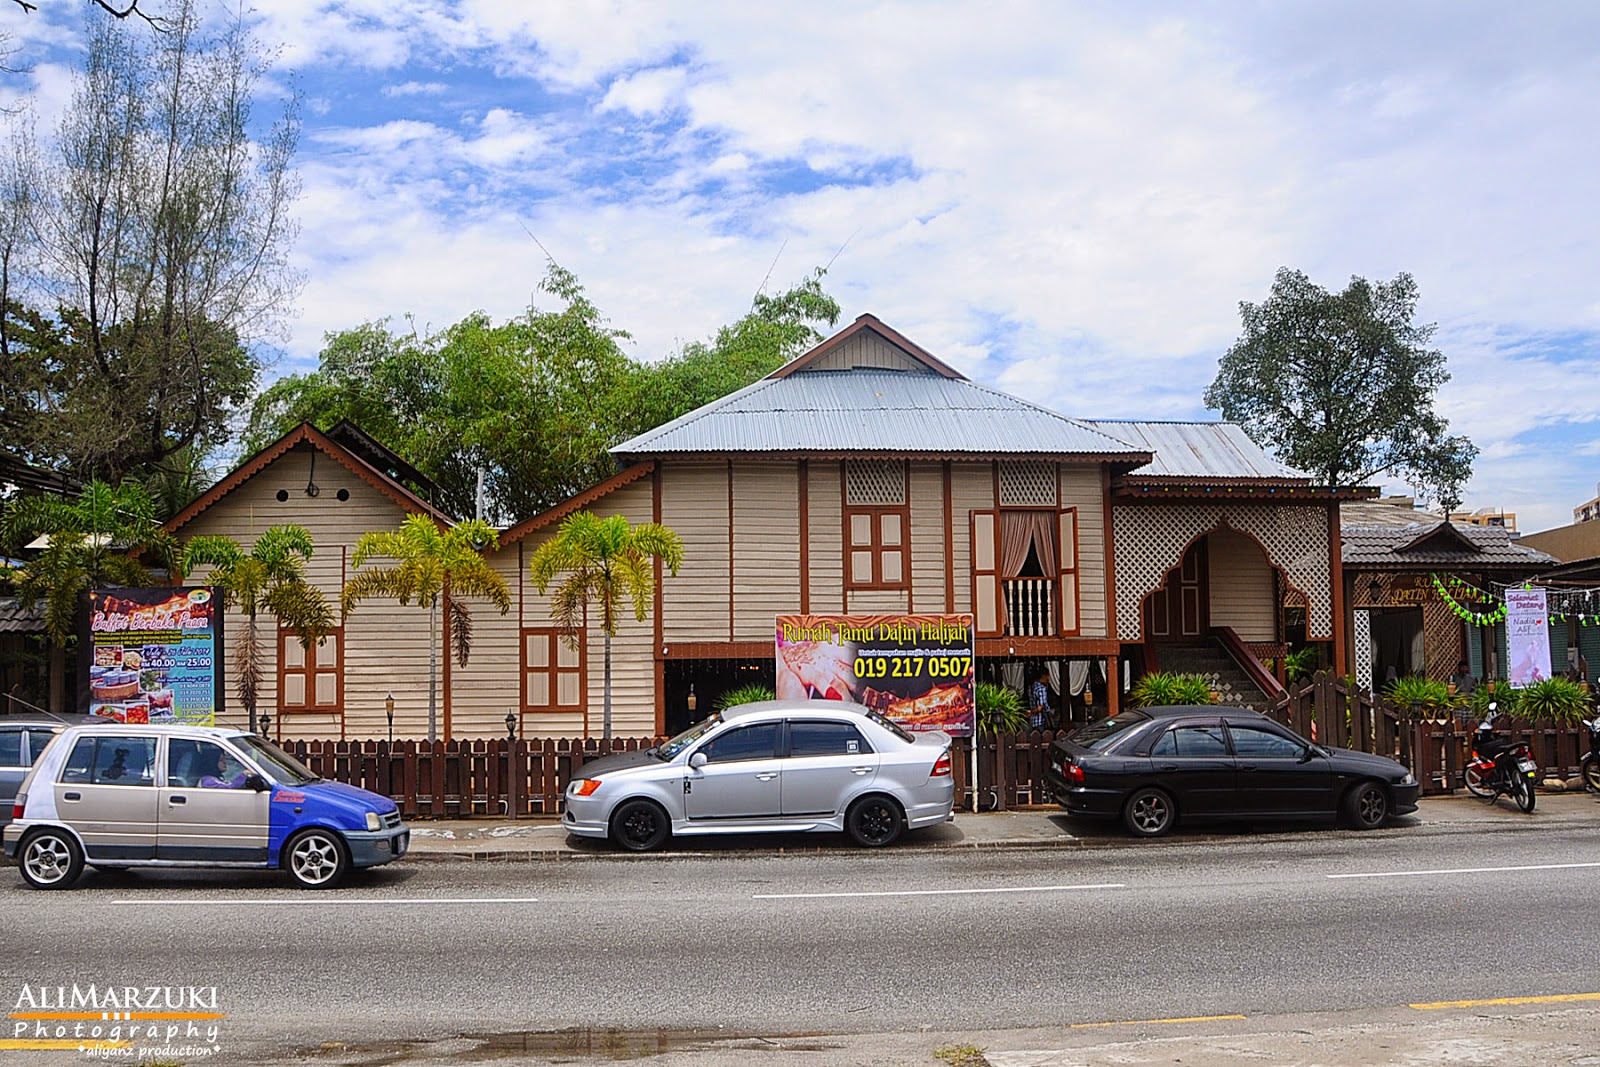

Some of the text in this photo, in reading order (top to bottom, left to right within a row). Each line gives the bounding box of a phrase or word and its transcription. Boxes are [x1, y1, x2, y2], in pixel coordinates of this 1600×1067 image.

[92, 612, 208, 632] Buffet Berbuka Puasa
[783, 618, 968, 647] Rumah Tamu Datin Halijah
[151, 659, 175, 667] 40.00
[187, 658, 211, 667] 25.00
[854, 657, 971, 678] 019 217 0507
